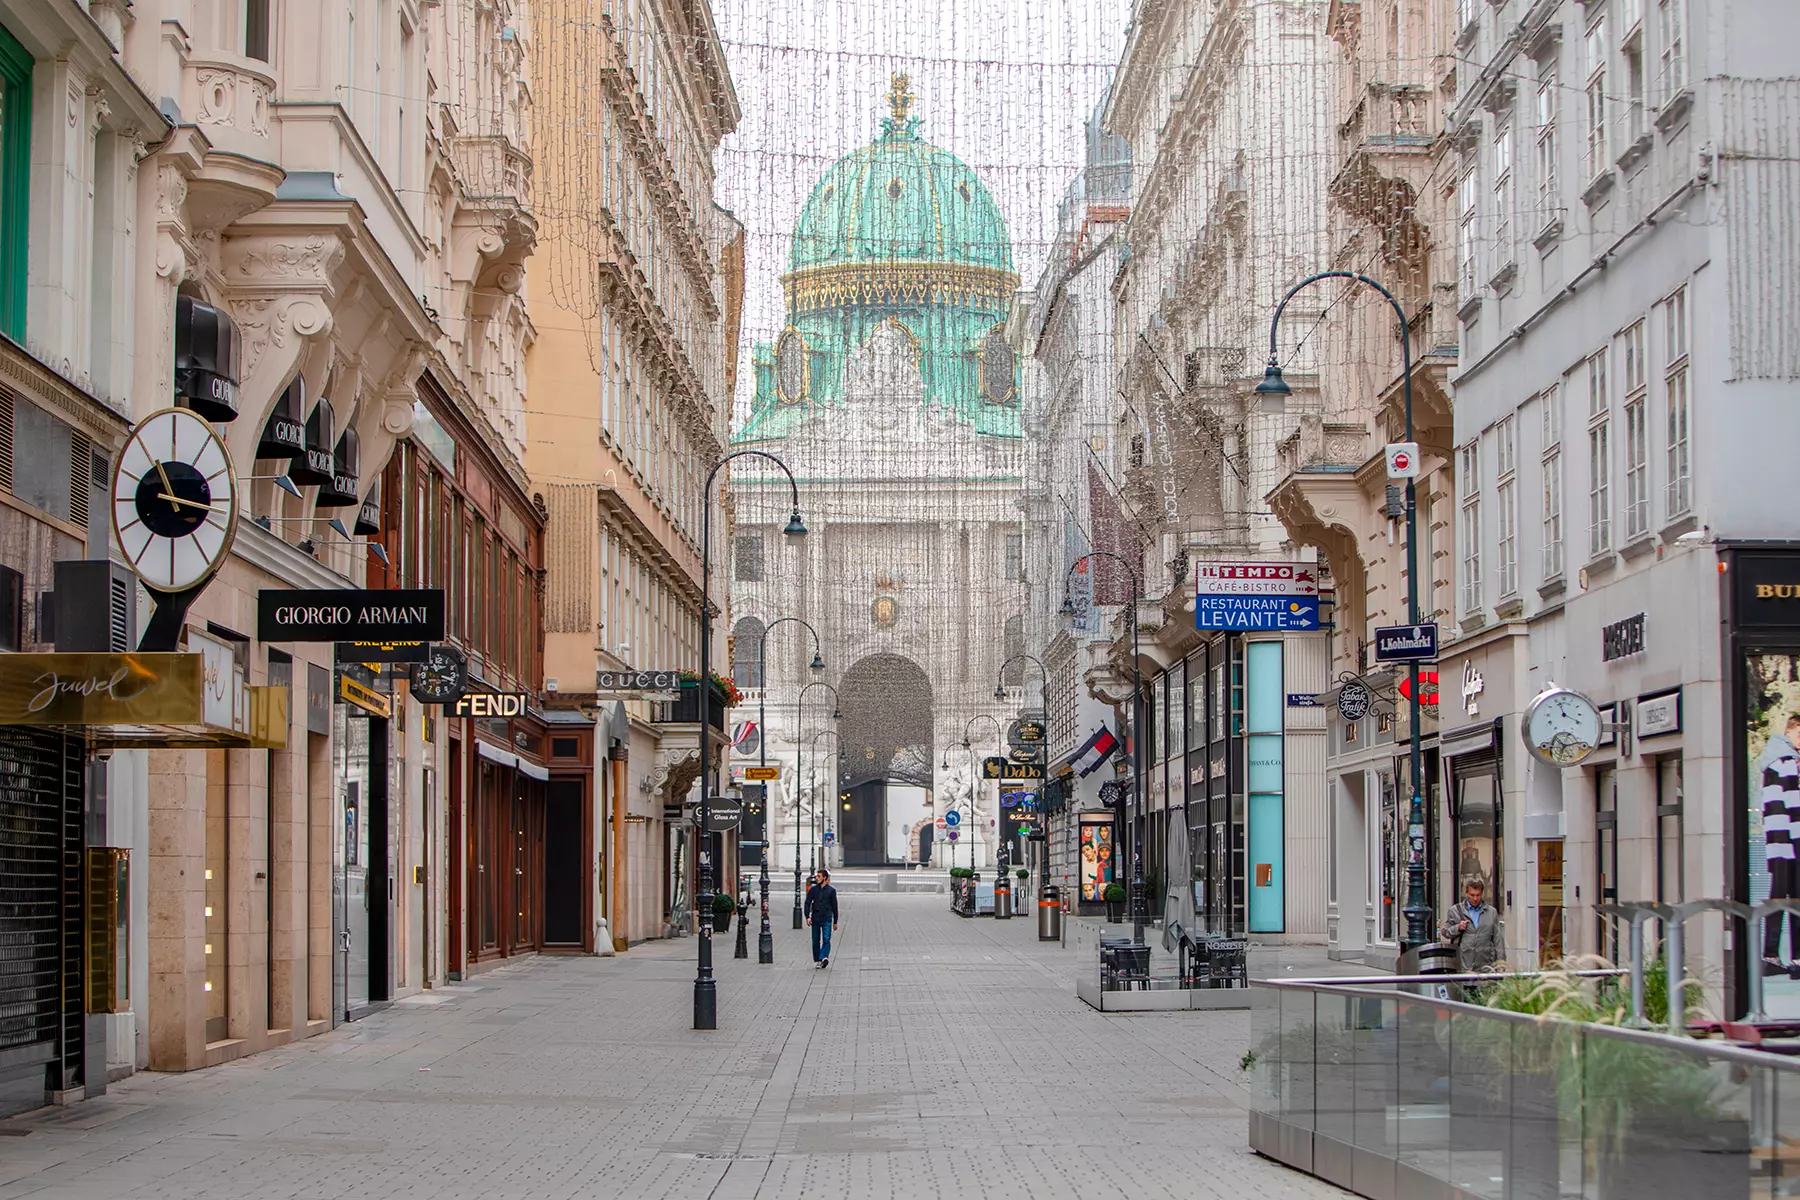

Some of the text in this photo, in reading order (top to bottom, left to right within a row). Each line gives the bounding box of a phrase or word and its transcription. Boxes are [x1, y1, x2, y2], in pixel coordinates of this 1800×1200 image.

[1219, 567, 1291, 578] TEMPO
[1201, 599, 1287, 610] RESTAURANT
[275, 605, 428, 626] GIORGIO ARMANI
[1201, 611, 1288, 627] LEVANTE
[601, 672, 676, 687] GUCCI
[28, 667, 148, 712] Juwel
[1340, 688, 1368, 702] Tabak
[456, 694, 526, 716] FENDI
[1340, 701, 1368, 713] Trafik
[1004, 766, 1041, 778] DoDo
